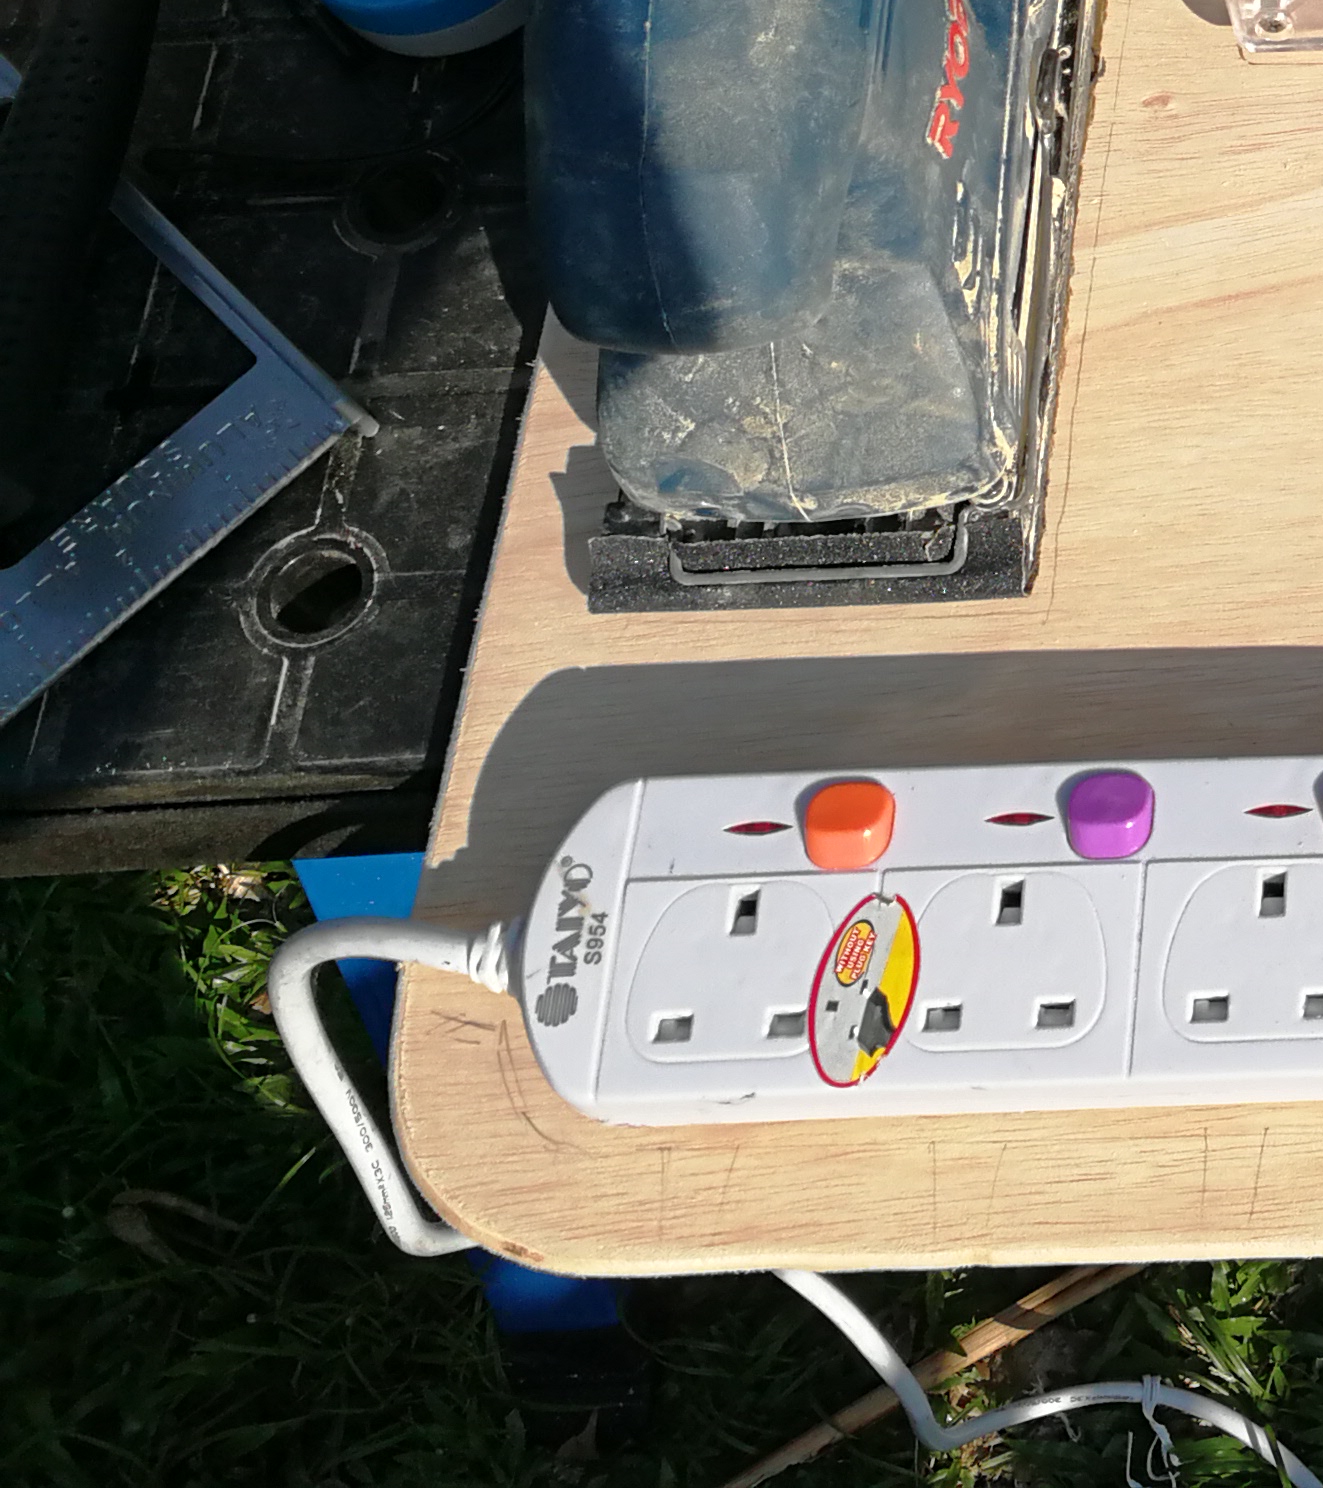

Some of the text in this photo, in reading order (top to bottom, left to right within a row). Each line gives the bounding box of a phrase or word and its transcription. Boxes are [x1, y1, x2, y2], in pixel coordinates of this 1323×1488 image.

[583, 911, 609, 966] S954
[835, 926, 860, 973] WITHOUT
[847, 939, 864, 969] USING
[851, 930, 877, 980] PLUG KEY
